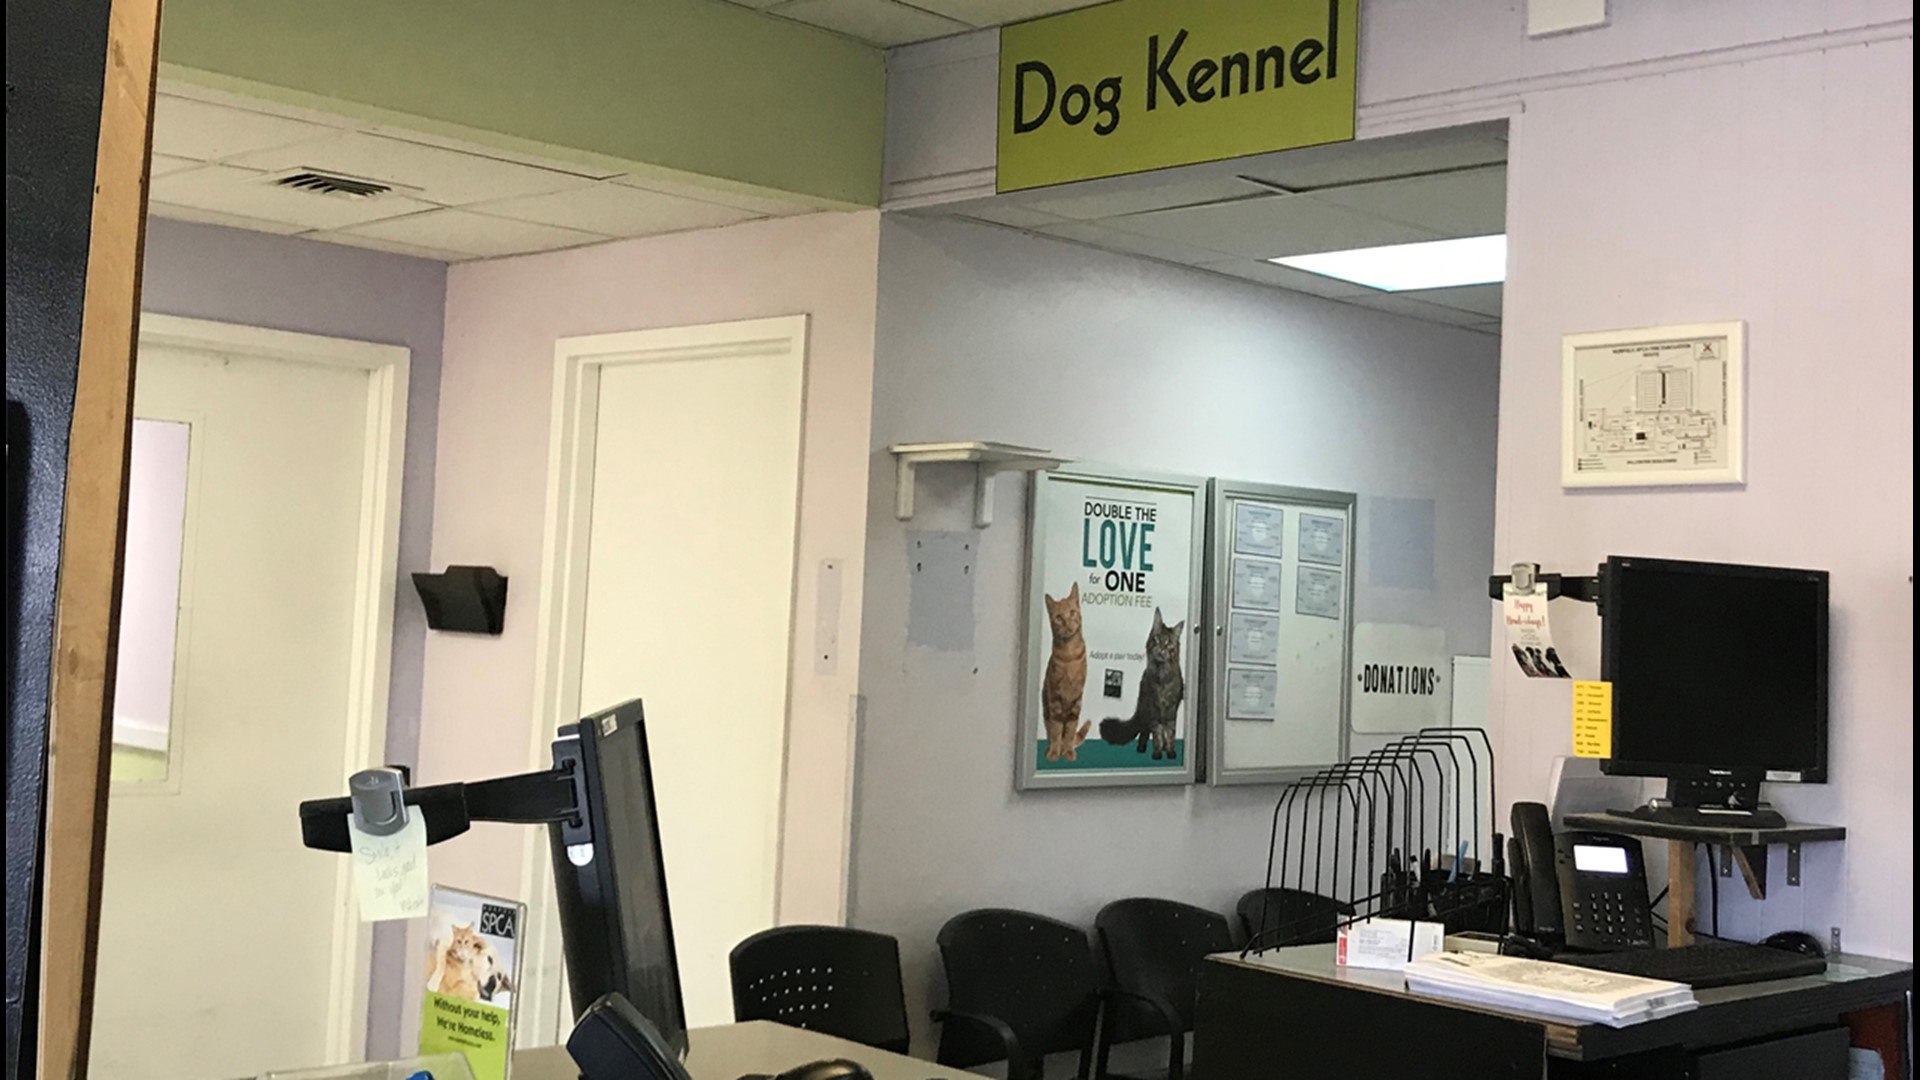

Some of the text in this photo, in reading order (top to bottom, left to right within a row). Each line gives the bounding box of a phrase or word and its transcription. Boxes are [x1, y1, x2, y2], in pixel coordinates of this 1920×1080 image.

[1013, 0, 1339, 136] Dog Kennel
[1084, 501, 1157, 522] DOUBLE THE
[1083, 517, 1155, 572] LOVE
[1088, 570, 1146, 593] for ONE
[1081, 592, 1152, 608] ADOPTION FEE
[1363, 664, 1435, 695] DONATIONS
[481, 911, 515, 938] SPCA
[434, 996, 501, 1027] Without your help,
[436, 1015, 457, 1032] We're
[457, 1021, 496, 1042] Homeless.
